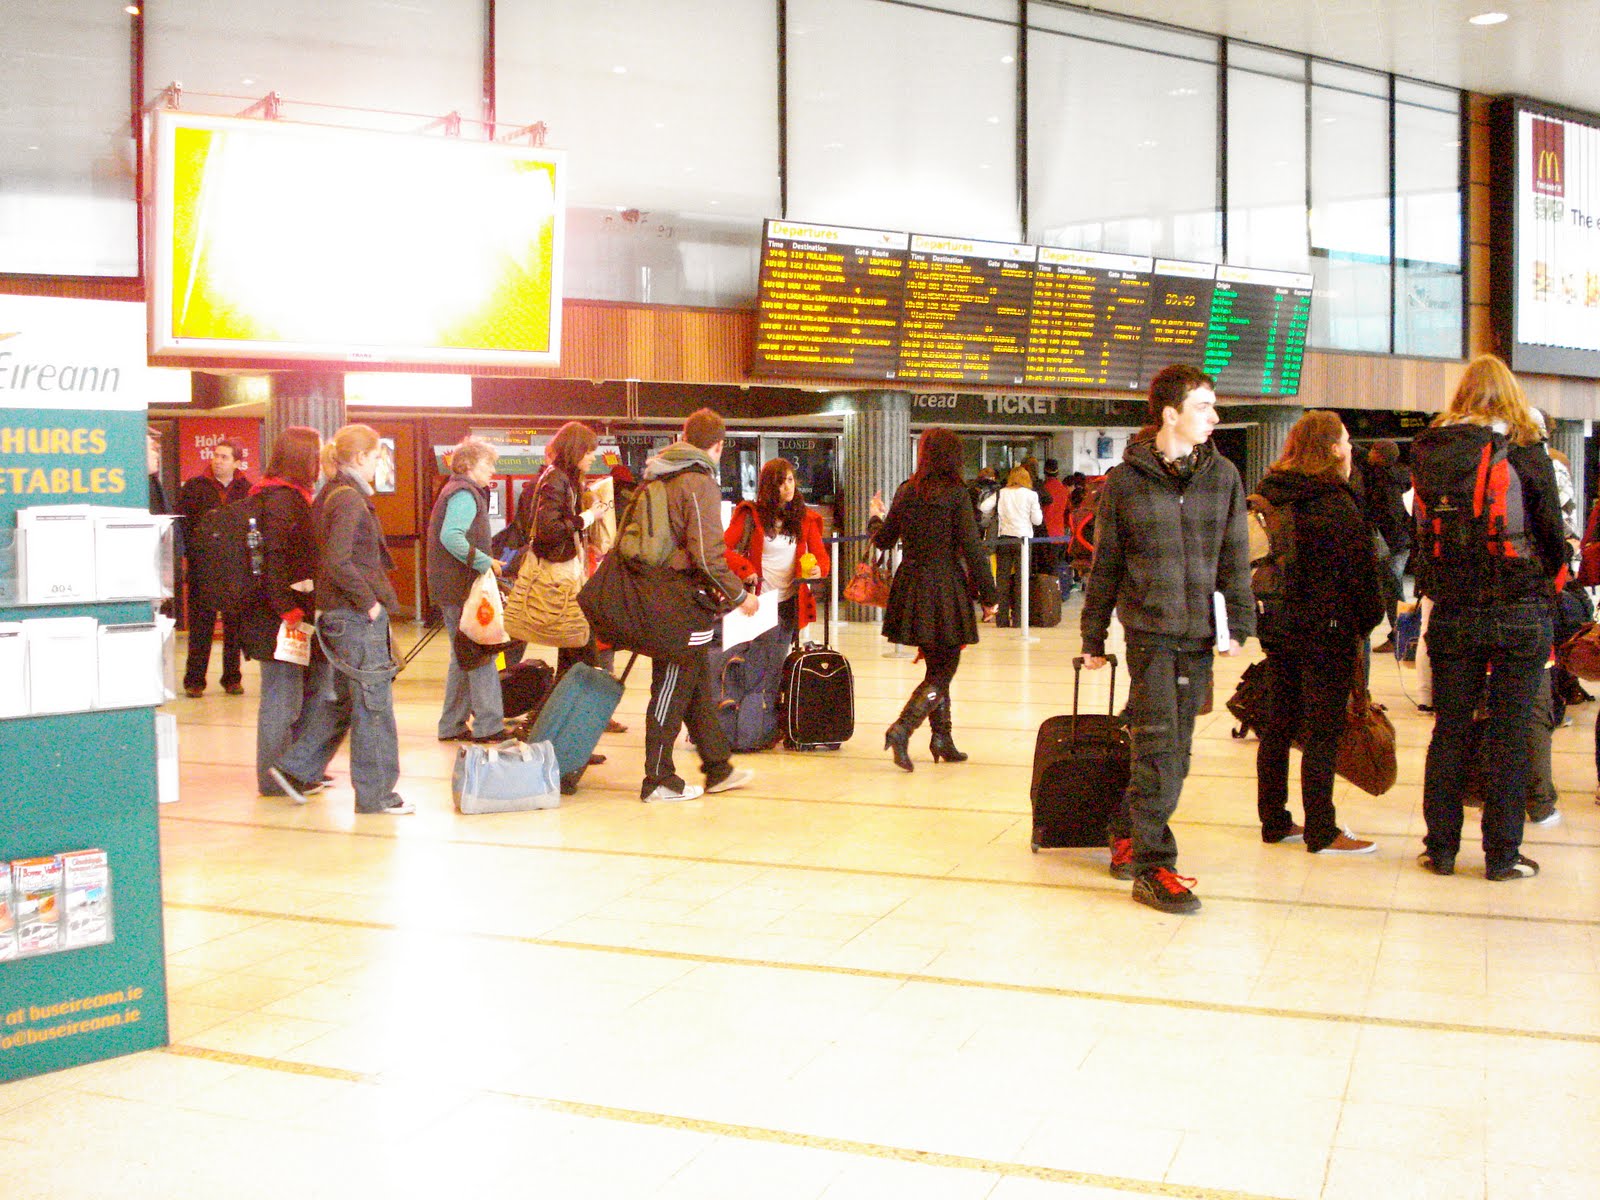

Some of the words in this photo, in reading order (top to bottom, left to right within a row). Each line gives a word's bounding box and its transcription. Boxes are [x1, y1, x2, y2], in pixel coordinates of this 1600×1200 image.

[1571, 208, 1593, 228] The
[773, 222, 838, 240] Departures
[768, 240, 784, 249] Time
[792, 242, 828, 252] Destination
[855, 248, 870, 257] Gate
[872, 250, 889, 258] Route
[915, 237, 974, 253] Departures
[911, 253, 925, 261] Time
[932, 255, 964, 264] Destination
[988, 260, 1000, 268] Gate
[1057, 266, 1086, 275] Destination
[983, 394, 1058, 415] TICKET
[0, 427, 107, 455] HURES
[195, 434, 225, 448] Hold
[5, 1009, 25, 1026] at
[29, 985, 144, 1021] buseireann.ie
